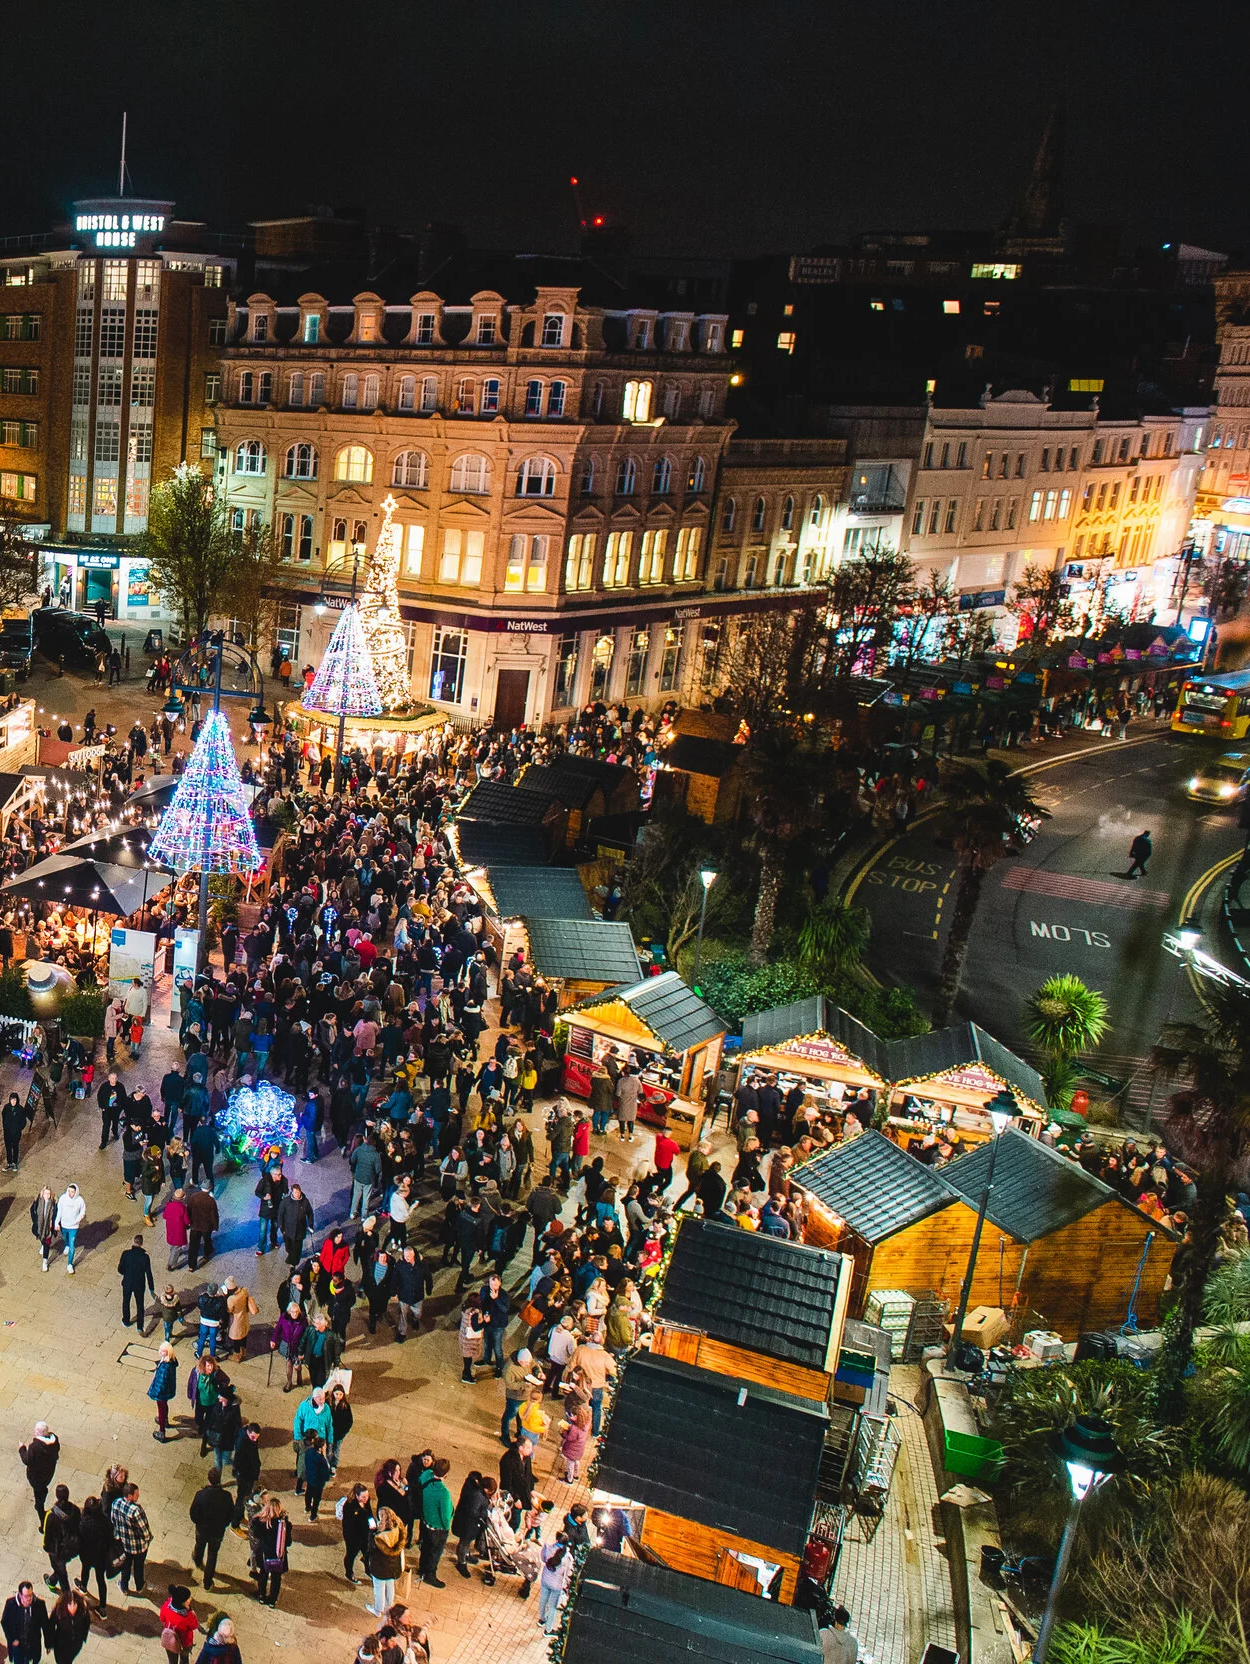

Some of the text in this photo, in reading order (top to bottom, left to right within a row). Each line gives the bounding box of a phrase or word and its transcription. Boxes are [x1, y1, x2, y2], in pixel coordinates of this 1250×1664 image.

[76, 215, 165, 231] BRISTOL & WEST
[96, 232, 136, 247] HOUSE
[507, 620, 548, 631] NatWest
[888, 856, 942, 875] BUS
[868, 871, 937, 893] STOP
[1030, 920, 1111, 948] SLOW
[809, 1048, 829, 1058] HOG
[962, 1076, 984, 1087] HOG
